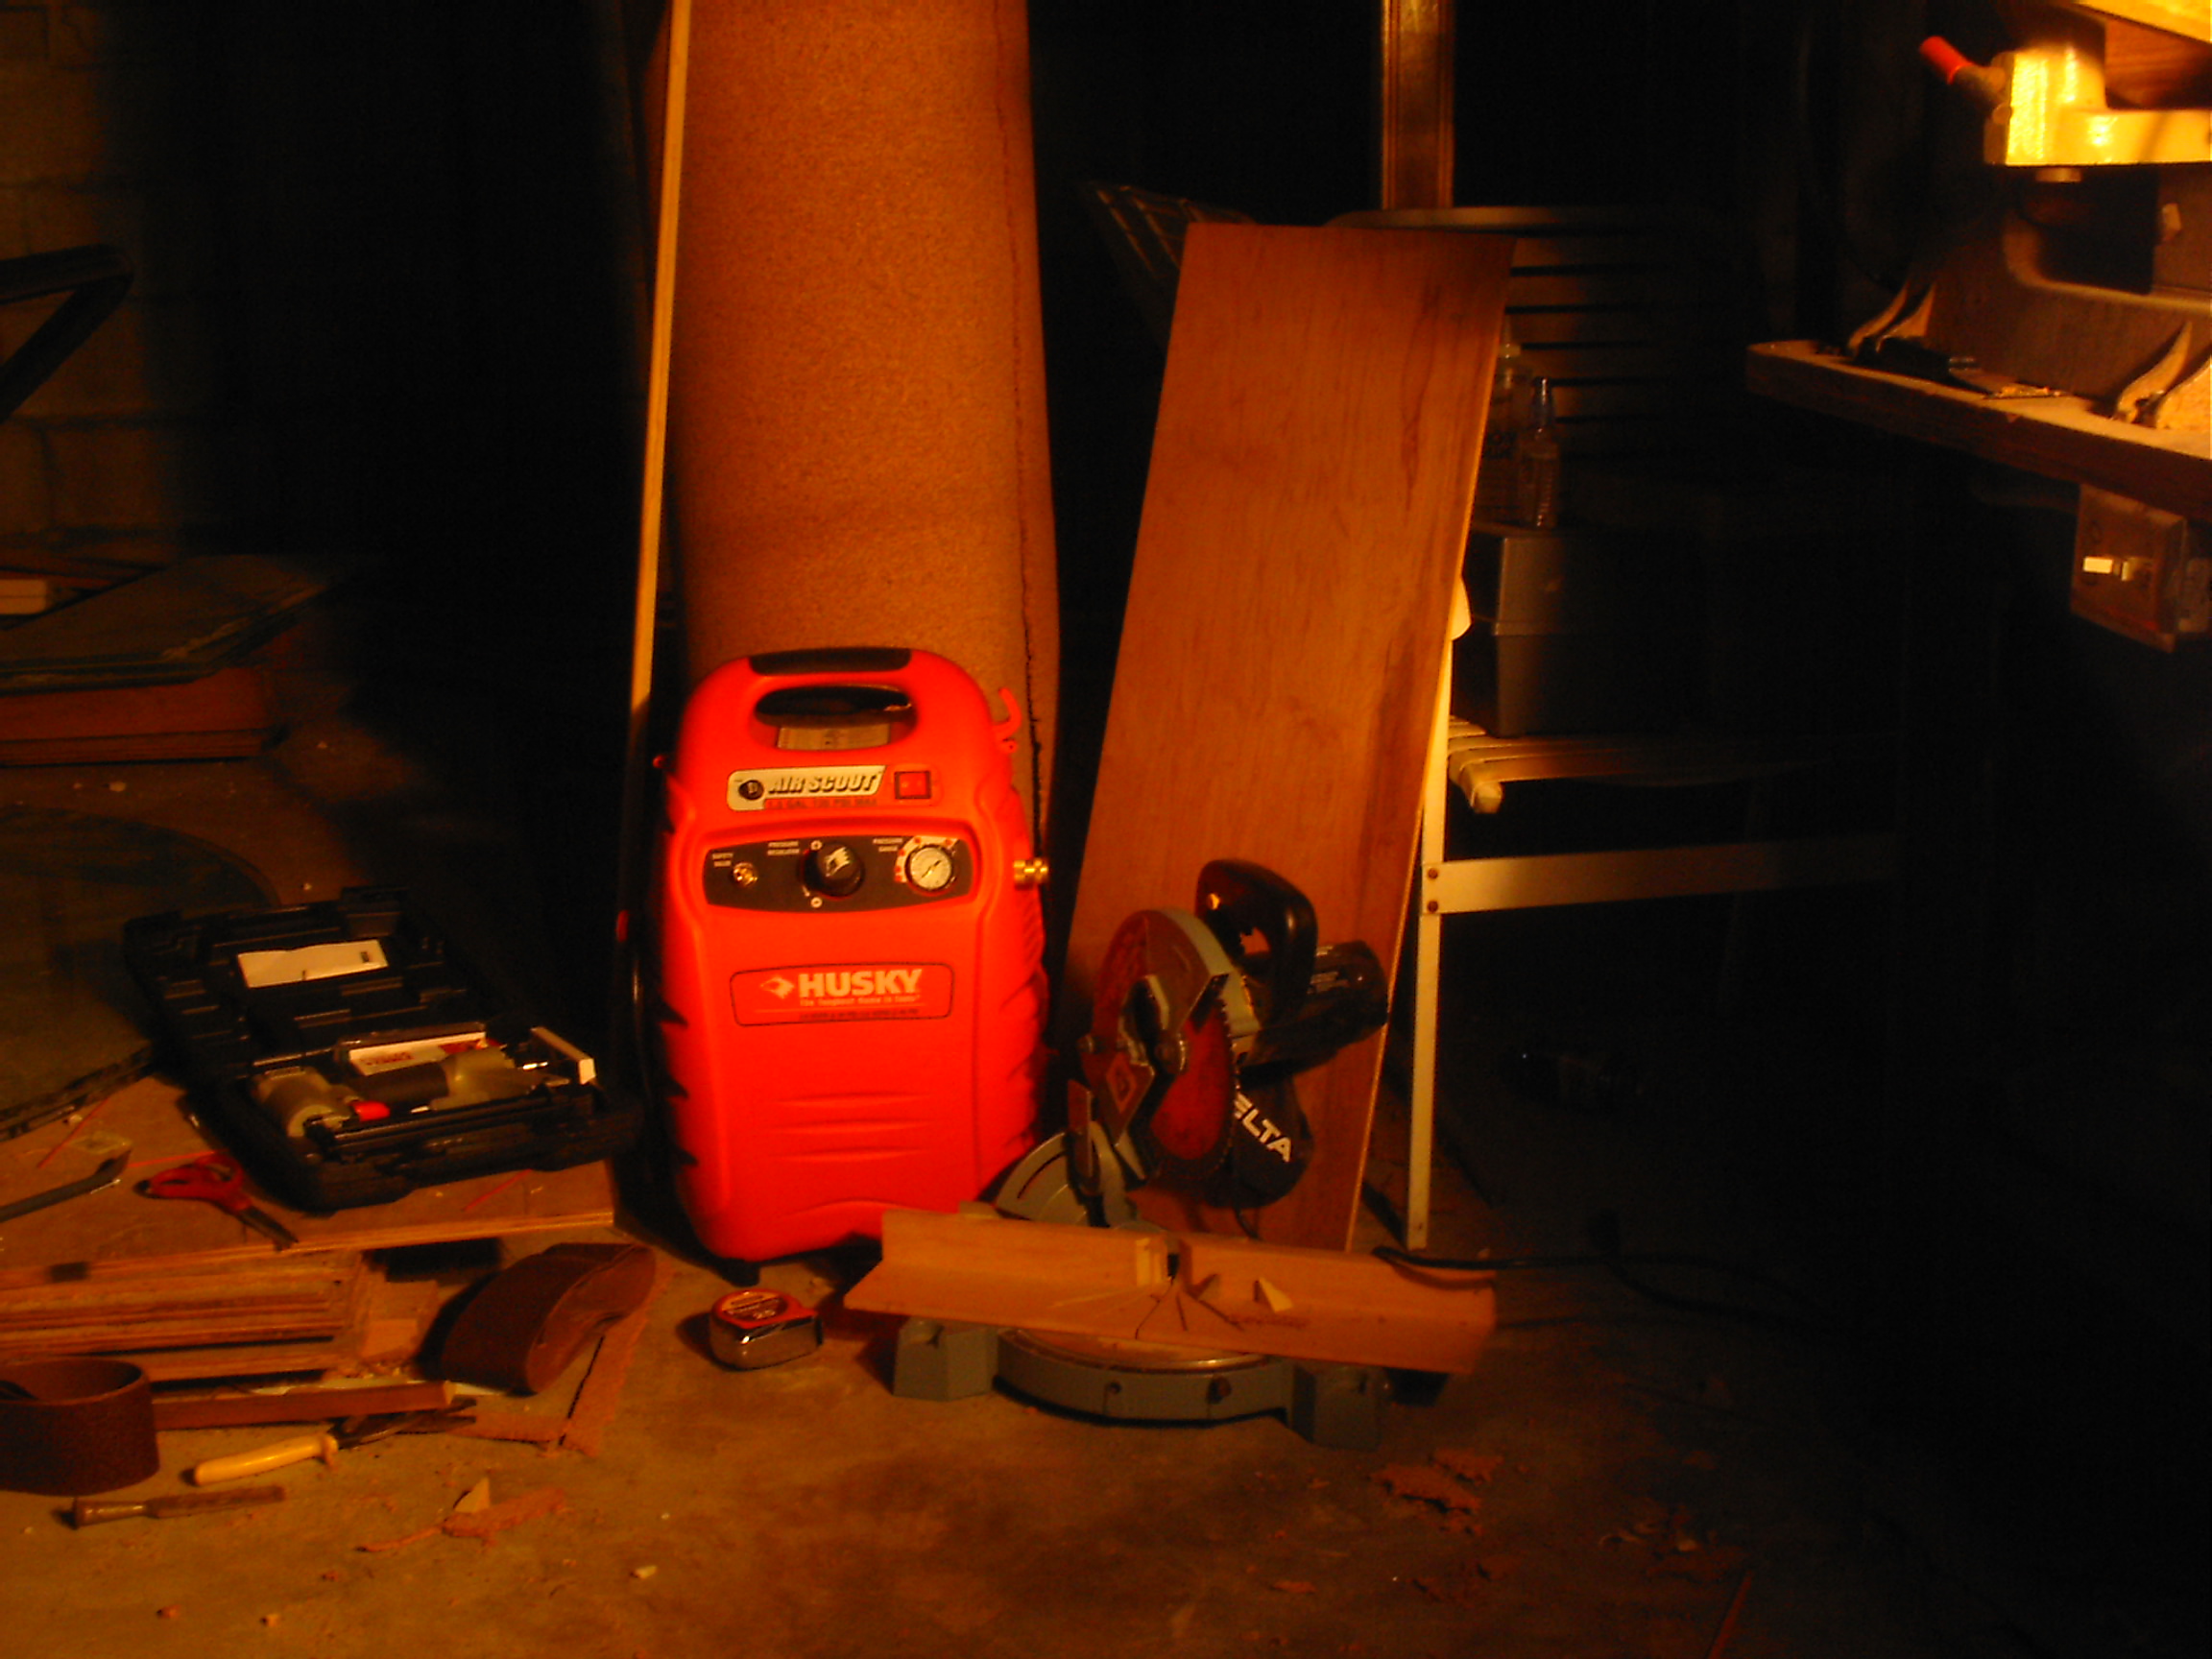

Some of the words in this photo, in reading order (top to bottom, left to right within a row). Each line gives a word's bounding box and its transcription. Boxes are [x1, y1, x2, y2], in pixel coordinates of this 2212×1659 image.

[766, 776, 805, 795] AIR
[807, 773, 878, 793] SCOUT
[798, 969, 923, 998] HUSKY
[1233, 1091, 1292, 1163] ELTA
